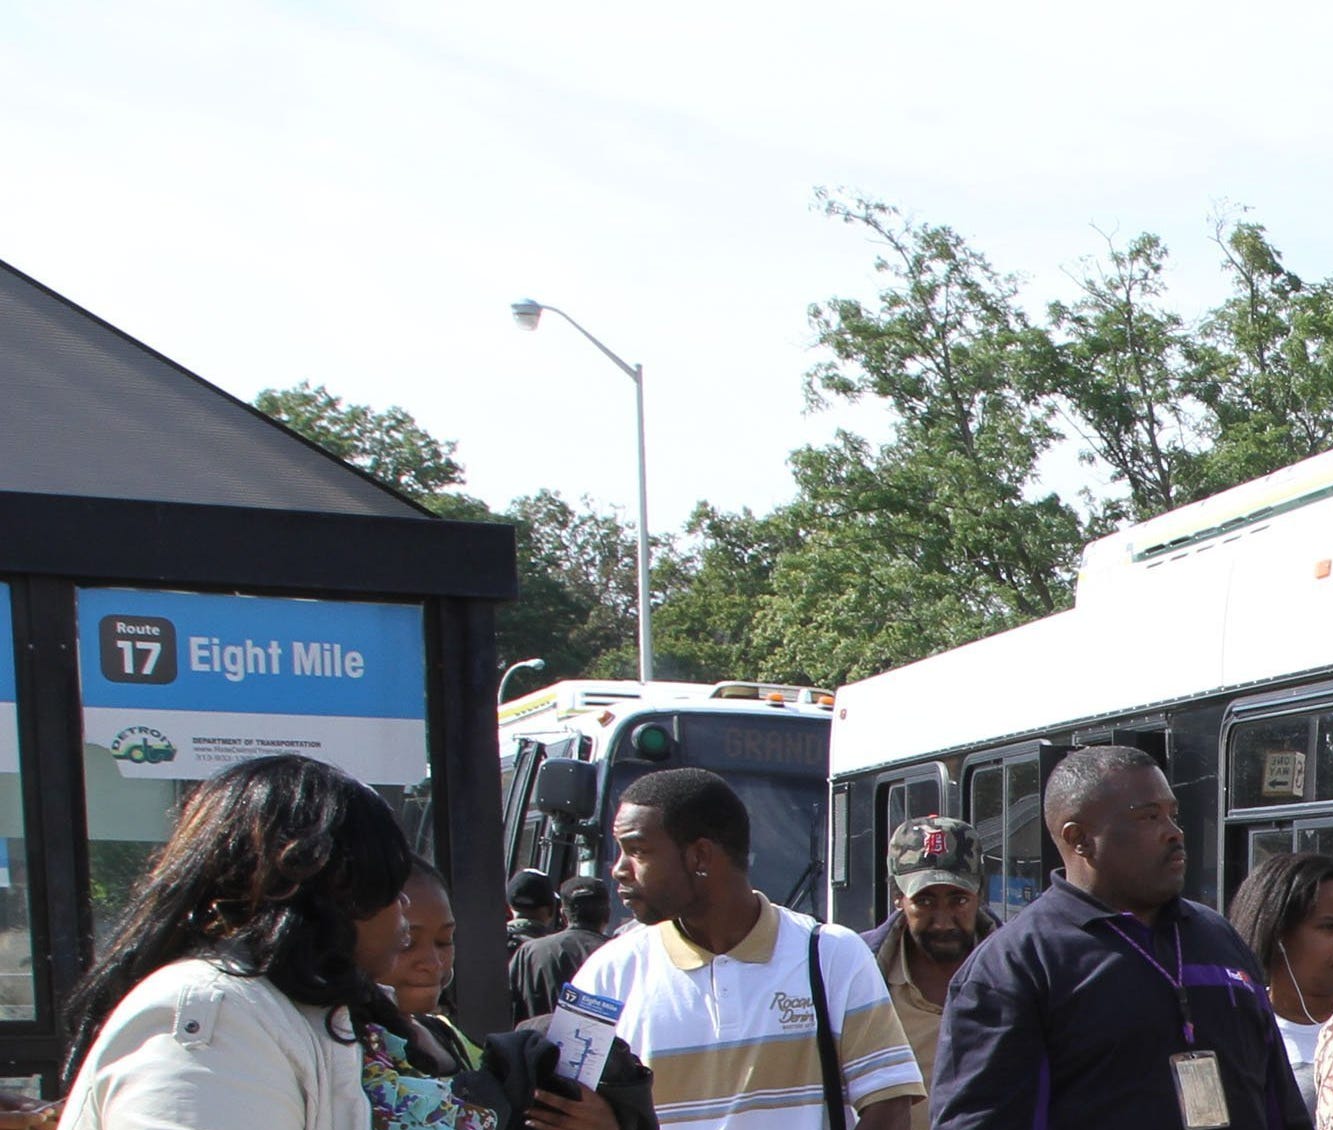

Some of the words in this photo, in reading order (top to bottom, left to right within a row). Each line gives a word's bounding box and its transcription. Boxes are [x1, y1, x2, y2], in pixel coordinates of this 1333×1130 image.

[116, 621, 161, 636] Route
[116, 640, 162, 676] 17
[189, 636, 282, 682] Eight
[292, 641, 365, 678] Mile
[192, 737, 241, 745] DEPARTMENT
[243, 738, 253, 746] OF
[255, 739, 322, 748] TRANSPORTATION
[564, 992, 577, 1002] 17
